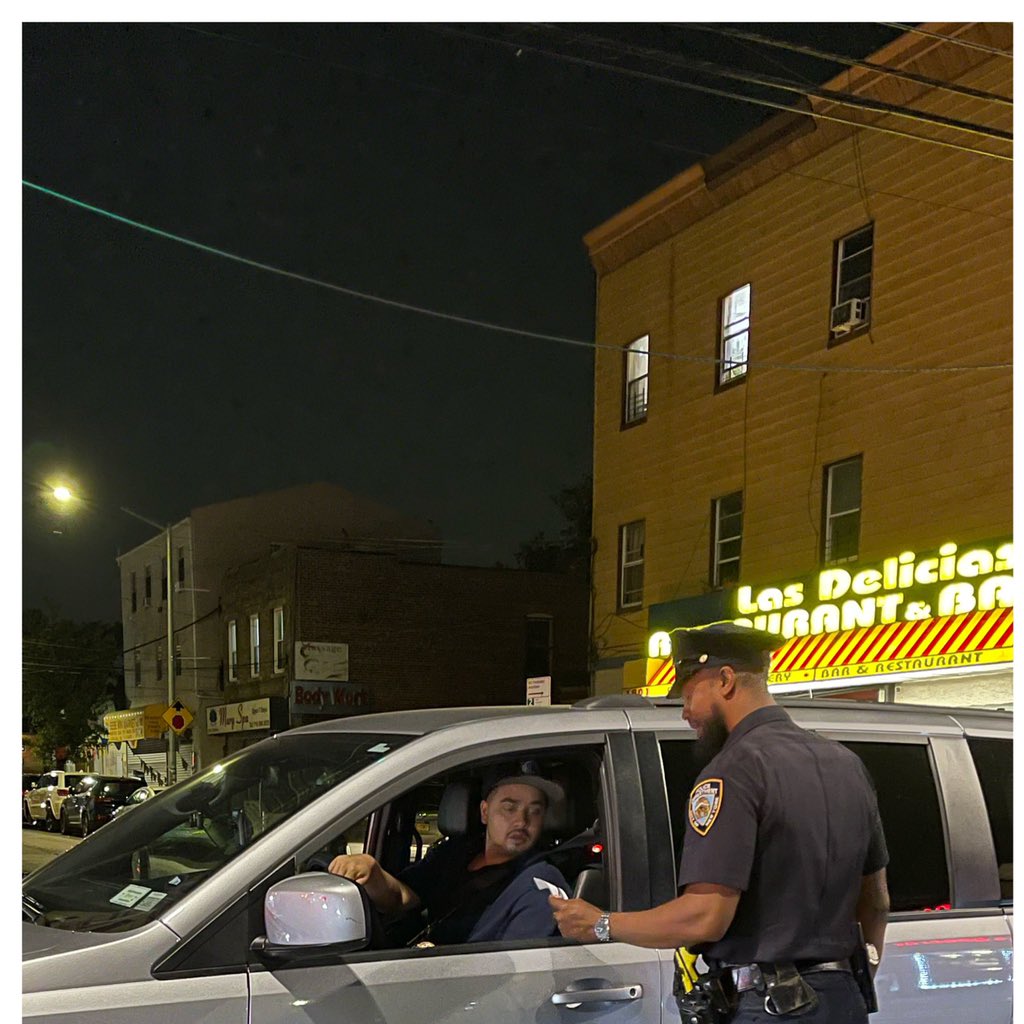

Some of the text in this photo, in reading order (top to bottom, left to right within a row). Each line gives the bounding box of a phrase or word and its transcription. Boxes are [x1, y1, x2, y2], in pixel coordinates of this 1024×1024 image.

[737, 543, 1013, 614] Las Delicias
[904, 600, 932, 621] &
[821, 665, 850, 679] BAR
[856, 663, 869, 675] &
[875, 651, 983, 673] RESTAURANT
